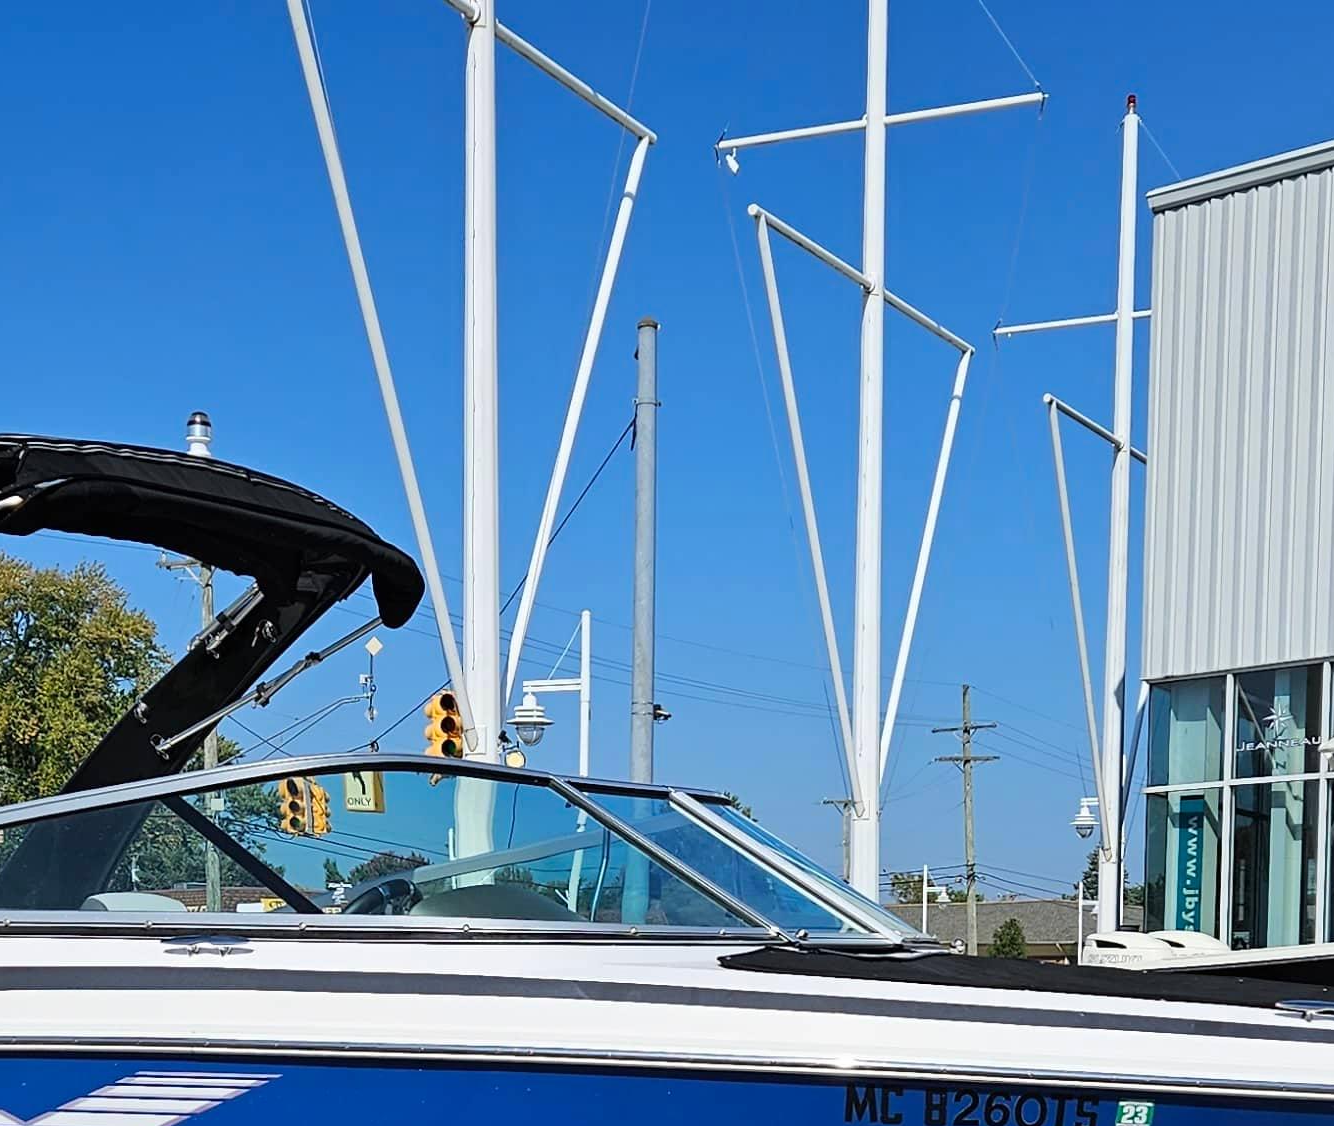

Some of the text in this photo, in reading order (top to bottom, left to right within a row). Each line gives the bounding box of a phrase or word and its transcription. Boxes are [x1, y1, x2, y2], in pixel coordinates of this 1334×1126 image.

[1236, 736, 1322, 752] JEANNEAU
[347, 797, 372, 806] ONLY
[844, 1084, 905, 1125] MC
[1120, 1105, 1148, 1124] 23
